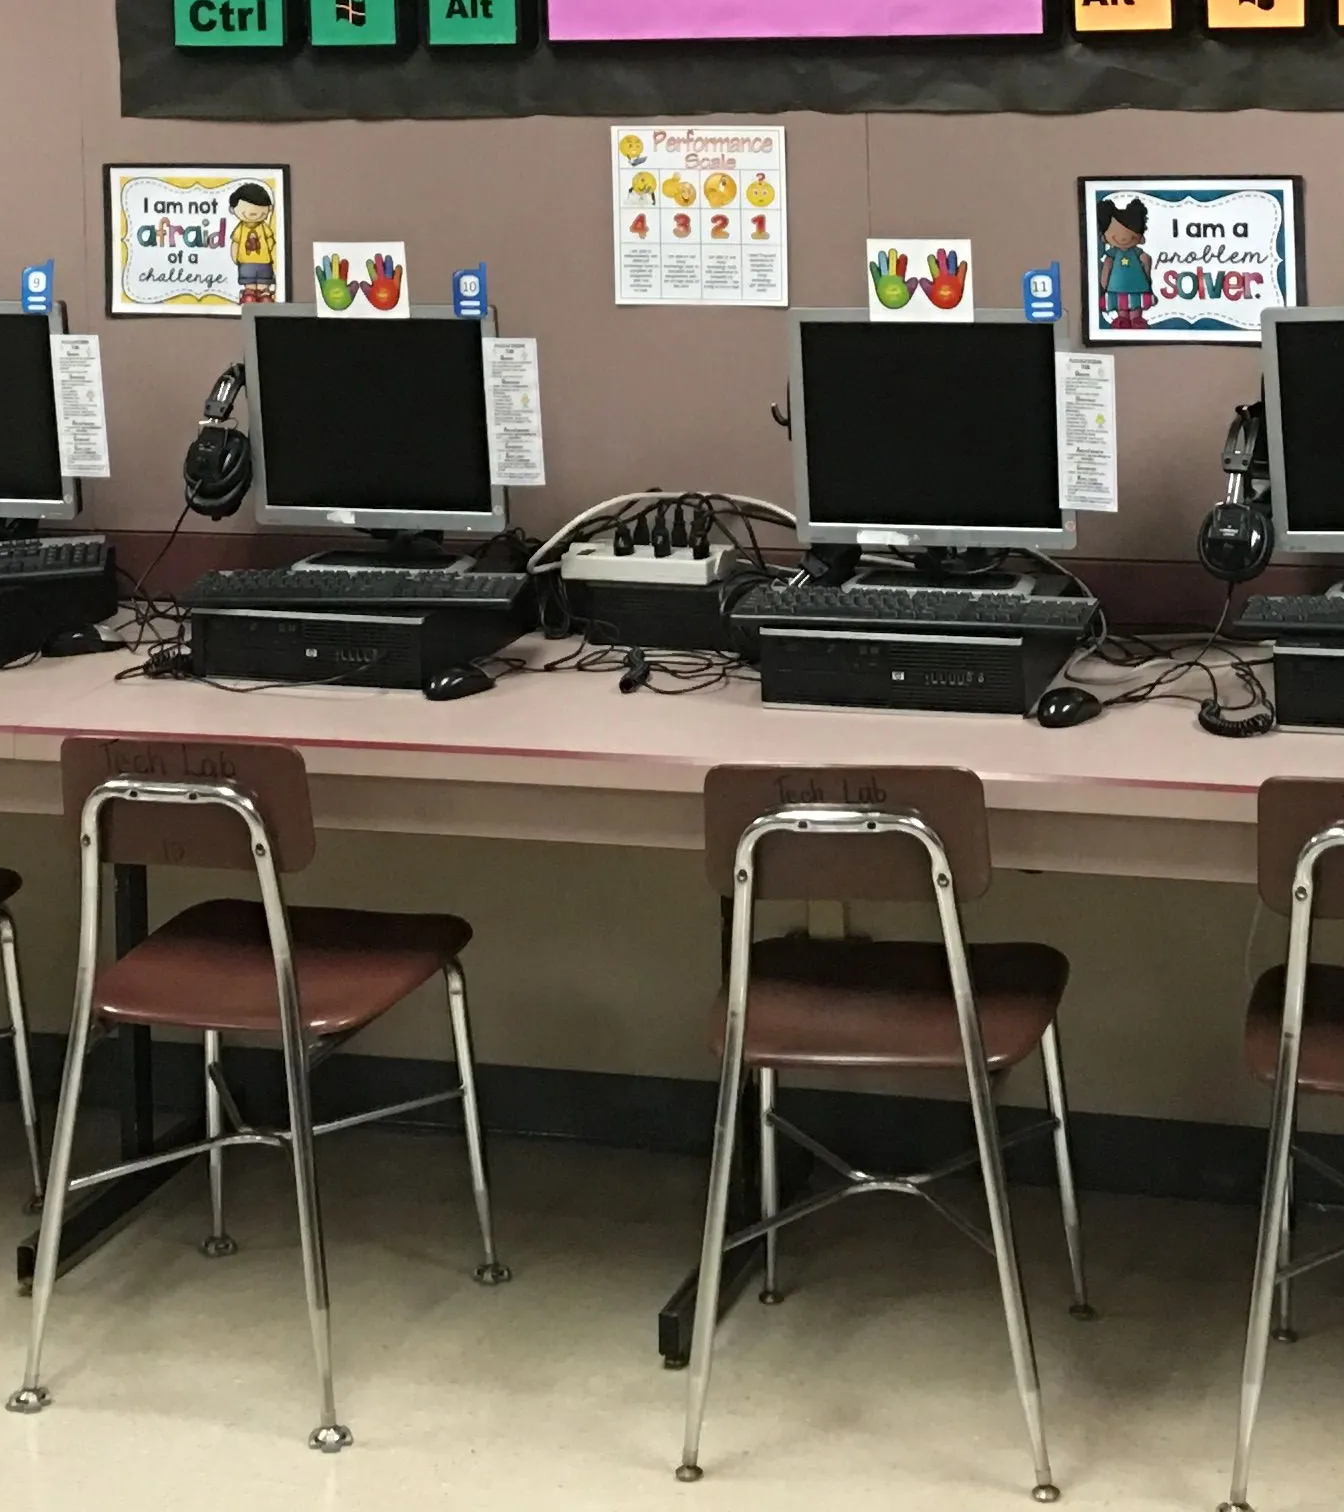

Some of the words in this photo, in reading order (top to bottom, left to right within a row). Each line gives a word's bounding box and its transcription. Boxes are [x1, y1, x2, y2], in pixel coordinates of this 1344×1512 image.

[652, 129, 773, 153] Performance
[684, 153, 737, 170] Scale
[143, 197, 149, 214] I
[153, 200, 184, 214] am
[188, 198, 218, 215] not
[136, 216, 227, 250] afraid
[629, 213, 649, 240] 4
[672, 212, 692, 238] 3
[710, 214, 730, 240] 2
[750, 214, 770, 240] 1
[1172, 218, 1178, 238] I
[1185, 221, 1226, 238] am
[1232, 221, 1249, 238] a
[167, 249, 184, 265] of
[188, 252, 199, 265] a
[1154, 244, 1270, 270] problem
[33, 277, 41, 288] 9
[462, 280, 478, 293] 10
[1030, 280, 1048, 293] 11
[1159, 266, 1264, 302] solver.
[97, 739, 167, 777] Tech
[181, 743, 236, 778] Lab
[842, 772, 888, 805] Lab
